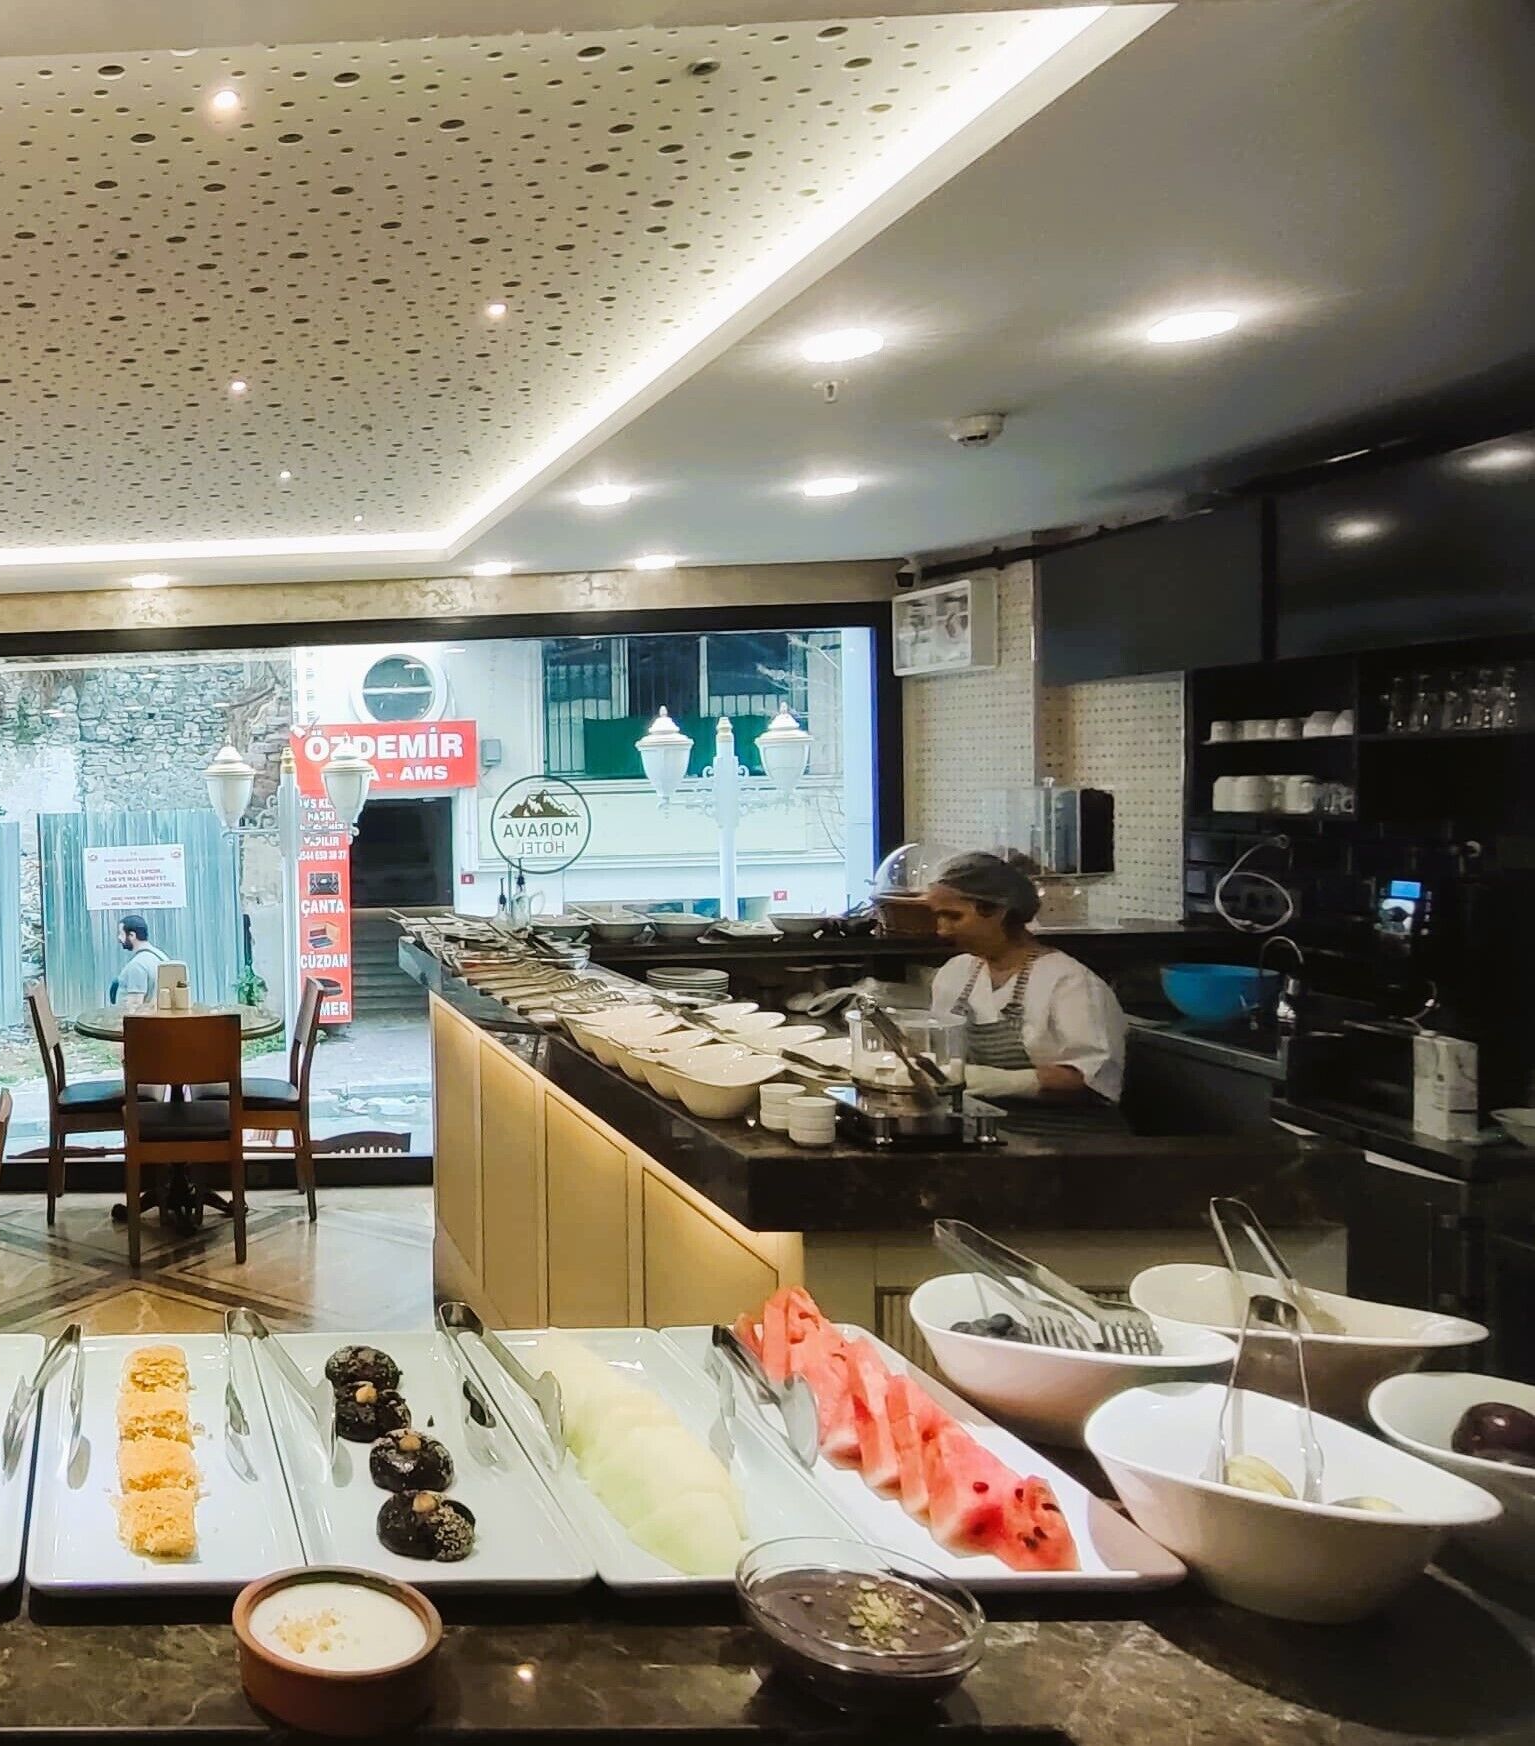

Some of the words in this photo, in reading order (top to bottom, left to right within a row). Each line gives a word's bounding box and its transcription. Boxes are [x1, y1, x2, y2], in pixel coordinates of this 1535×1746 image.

[399, 766, 448, 781] AMS
[301, 899, 345, 918] ÇANTA
[300, 952, 348, 968] CÜZDAN
[319, 1001, 349, 1016] MER
